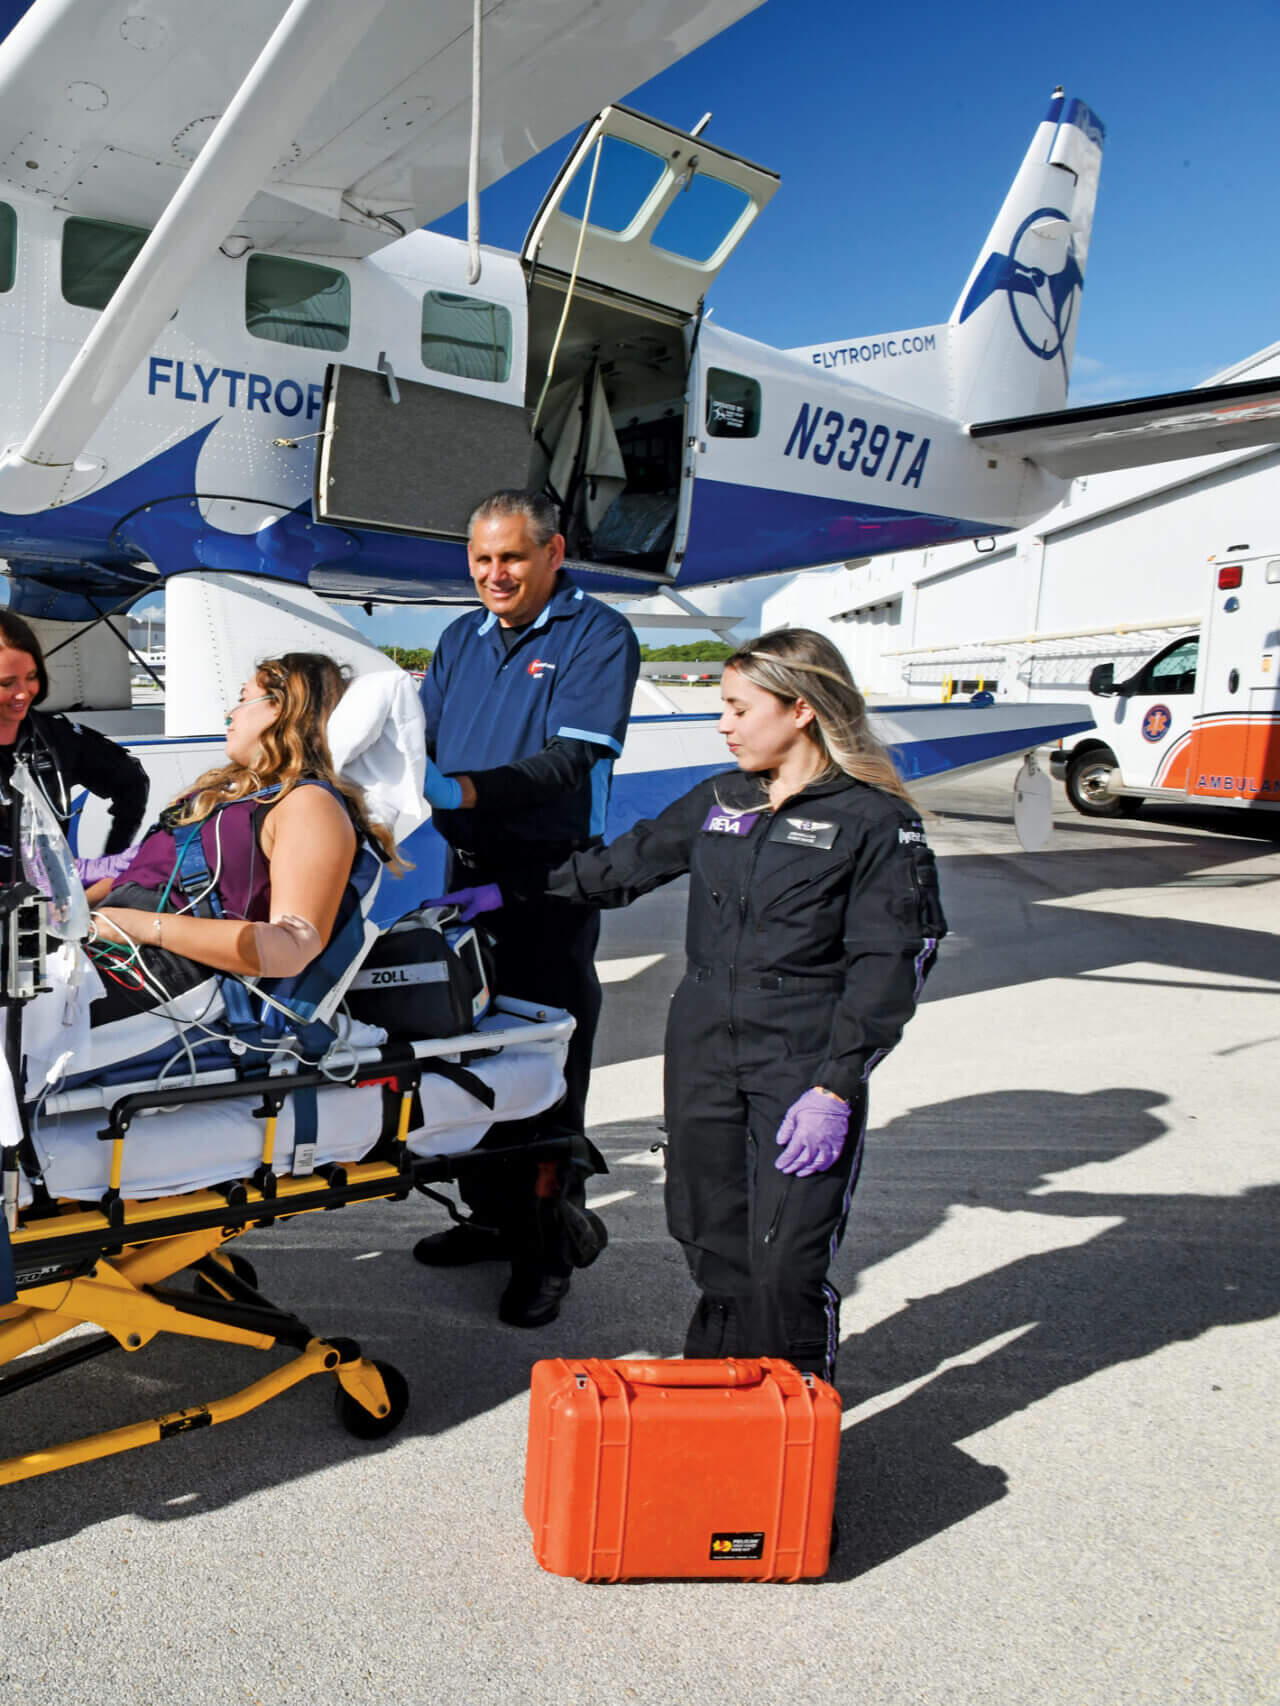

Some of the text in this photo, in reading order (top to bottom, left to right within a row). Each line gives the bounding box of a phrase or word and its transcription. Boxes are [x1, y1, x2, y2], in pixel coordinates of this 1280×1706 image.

[784, 402, 931, 489] N339TA
[708, 817, 740, 834] REVA
[371, 970, 409, 985] ZOLL
